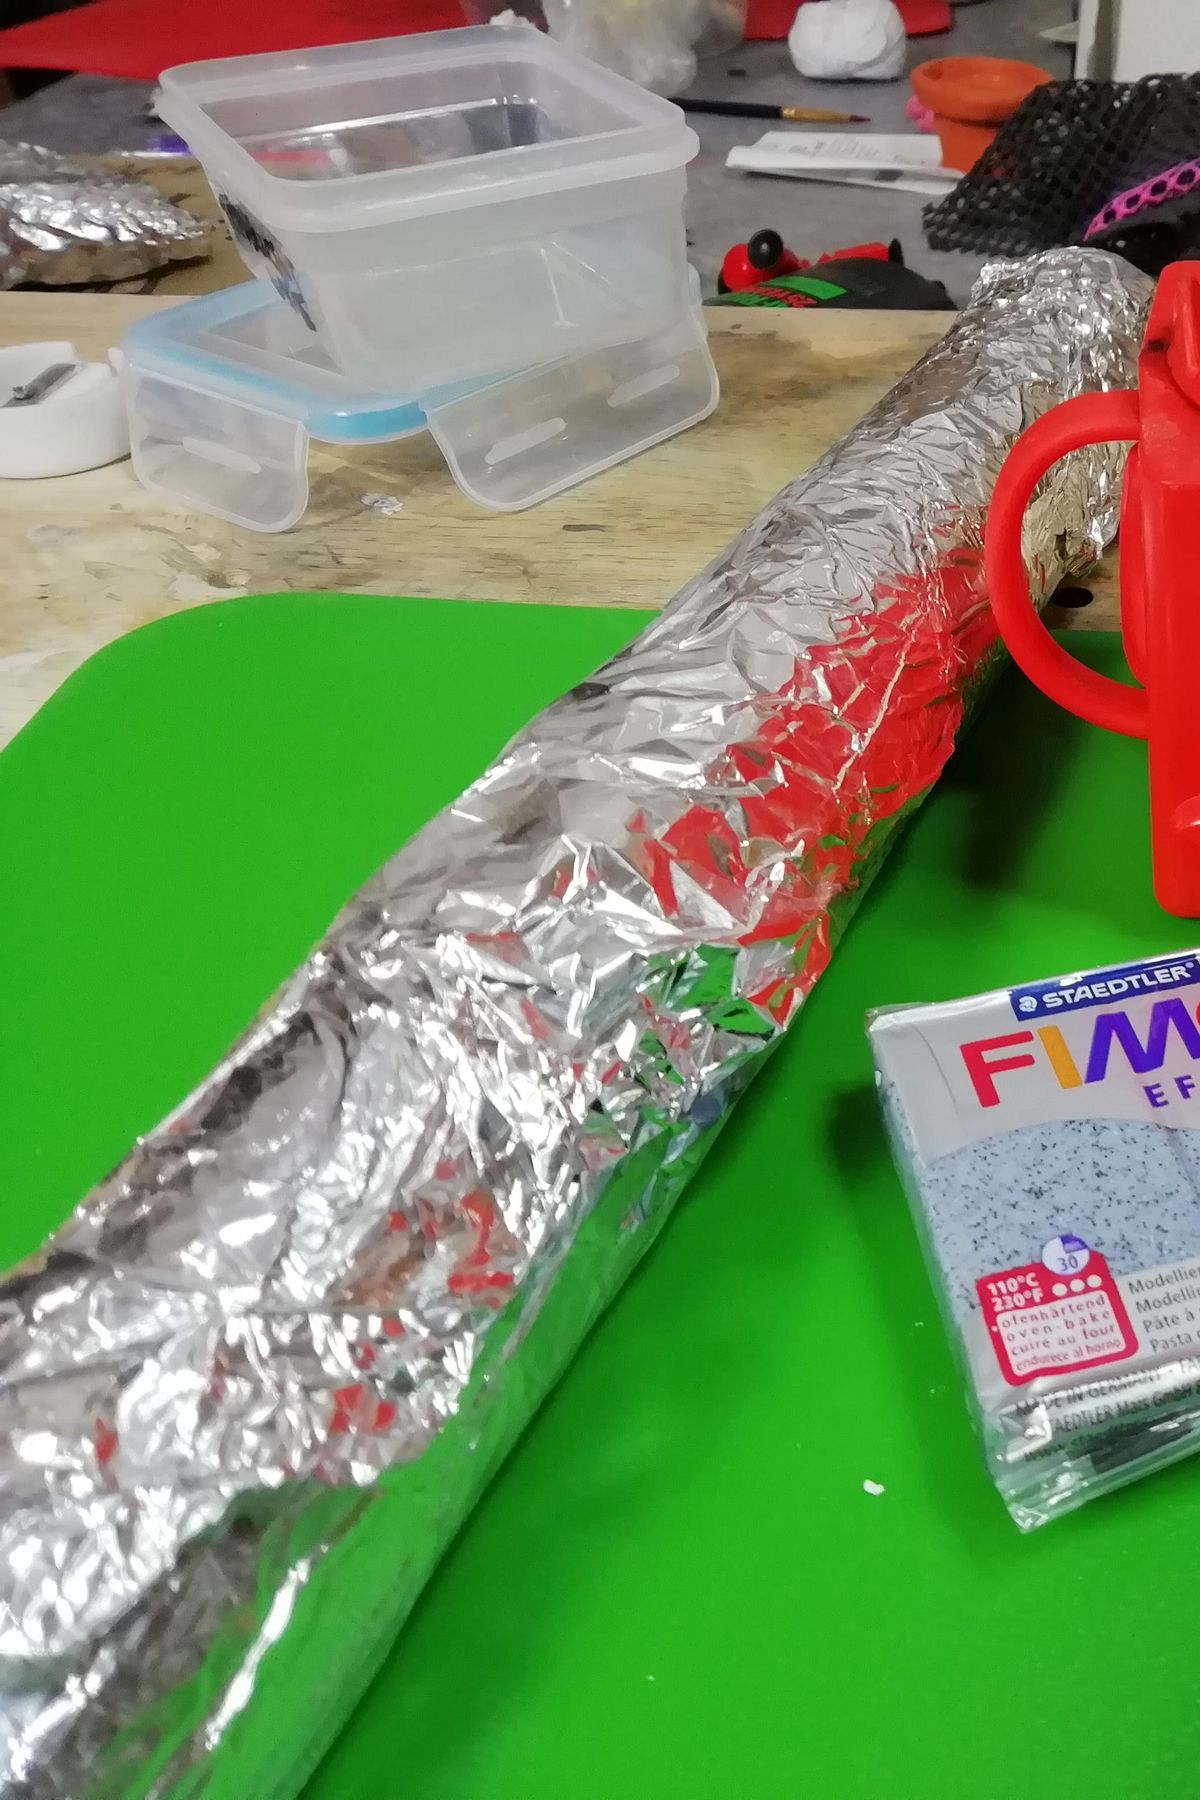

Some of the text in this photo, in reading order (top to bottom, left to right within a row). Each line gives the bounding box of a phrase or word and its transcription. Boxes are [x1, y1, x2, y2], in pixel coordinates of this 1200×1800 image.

[1042, 963, 1191, 1008] STAEDTLER
[1056, 1254, 1079, 1272] 30
[986, 1271, 1040, 1297] 110°C
[991, 1287, 1045, 1313] 230°F
[1006, 1311, 1111, 1342] oven-bake
[1142, 1314, 1180, 1334] Pâte
[1184, 1306, 1196, 1324] à
[1010, 1322, 1116, 1357] cuire au four
[1073, 1344, 1084, 1358] al
[1149, 1331, 1193, 1353] Pasta
